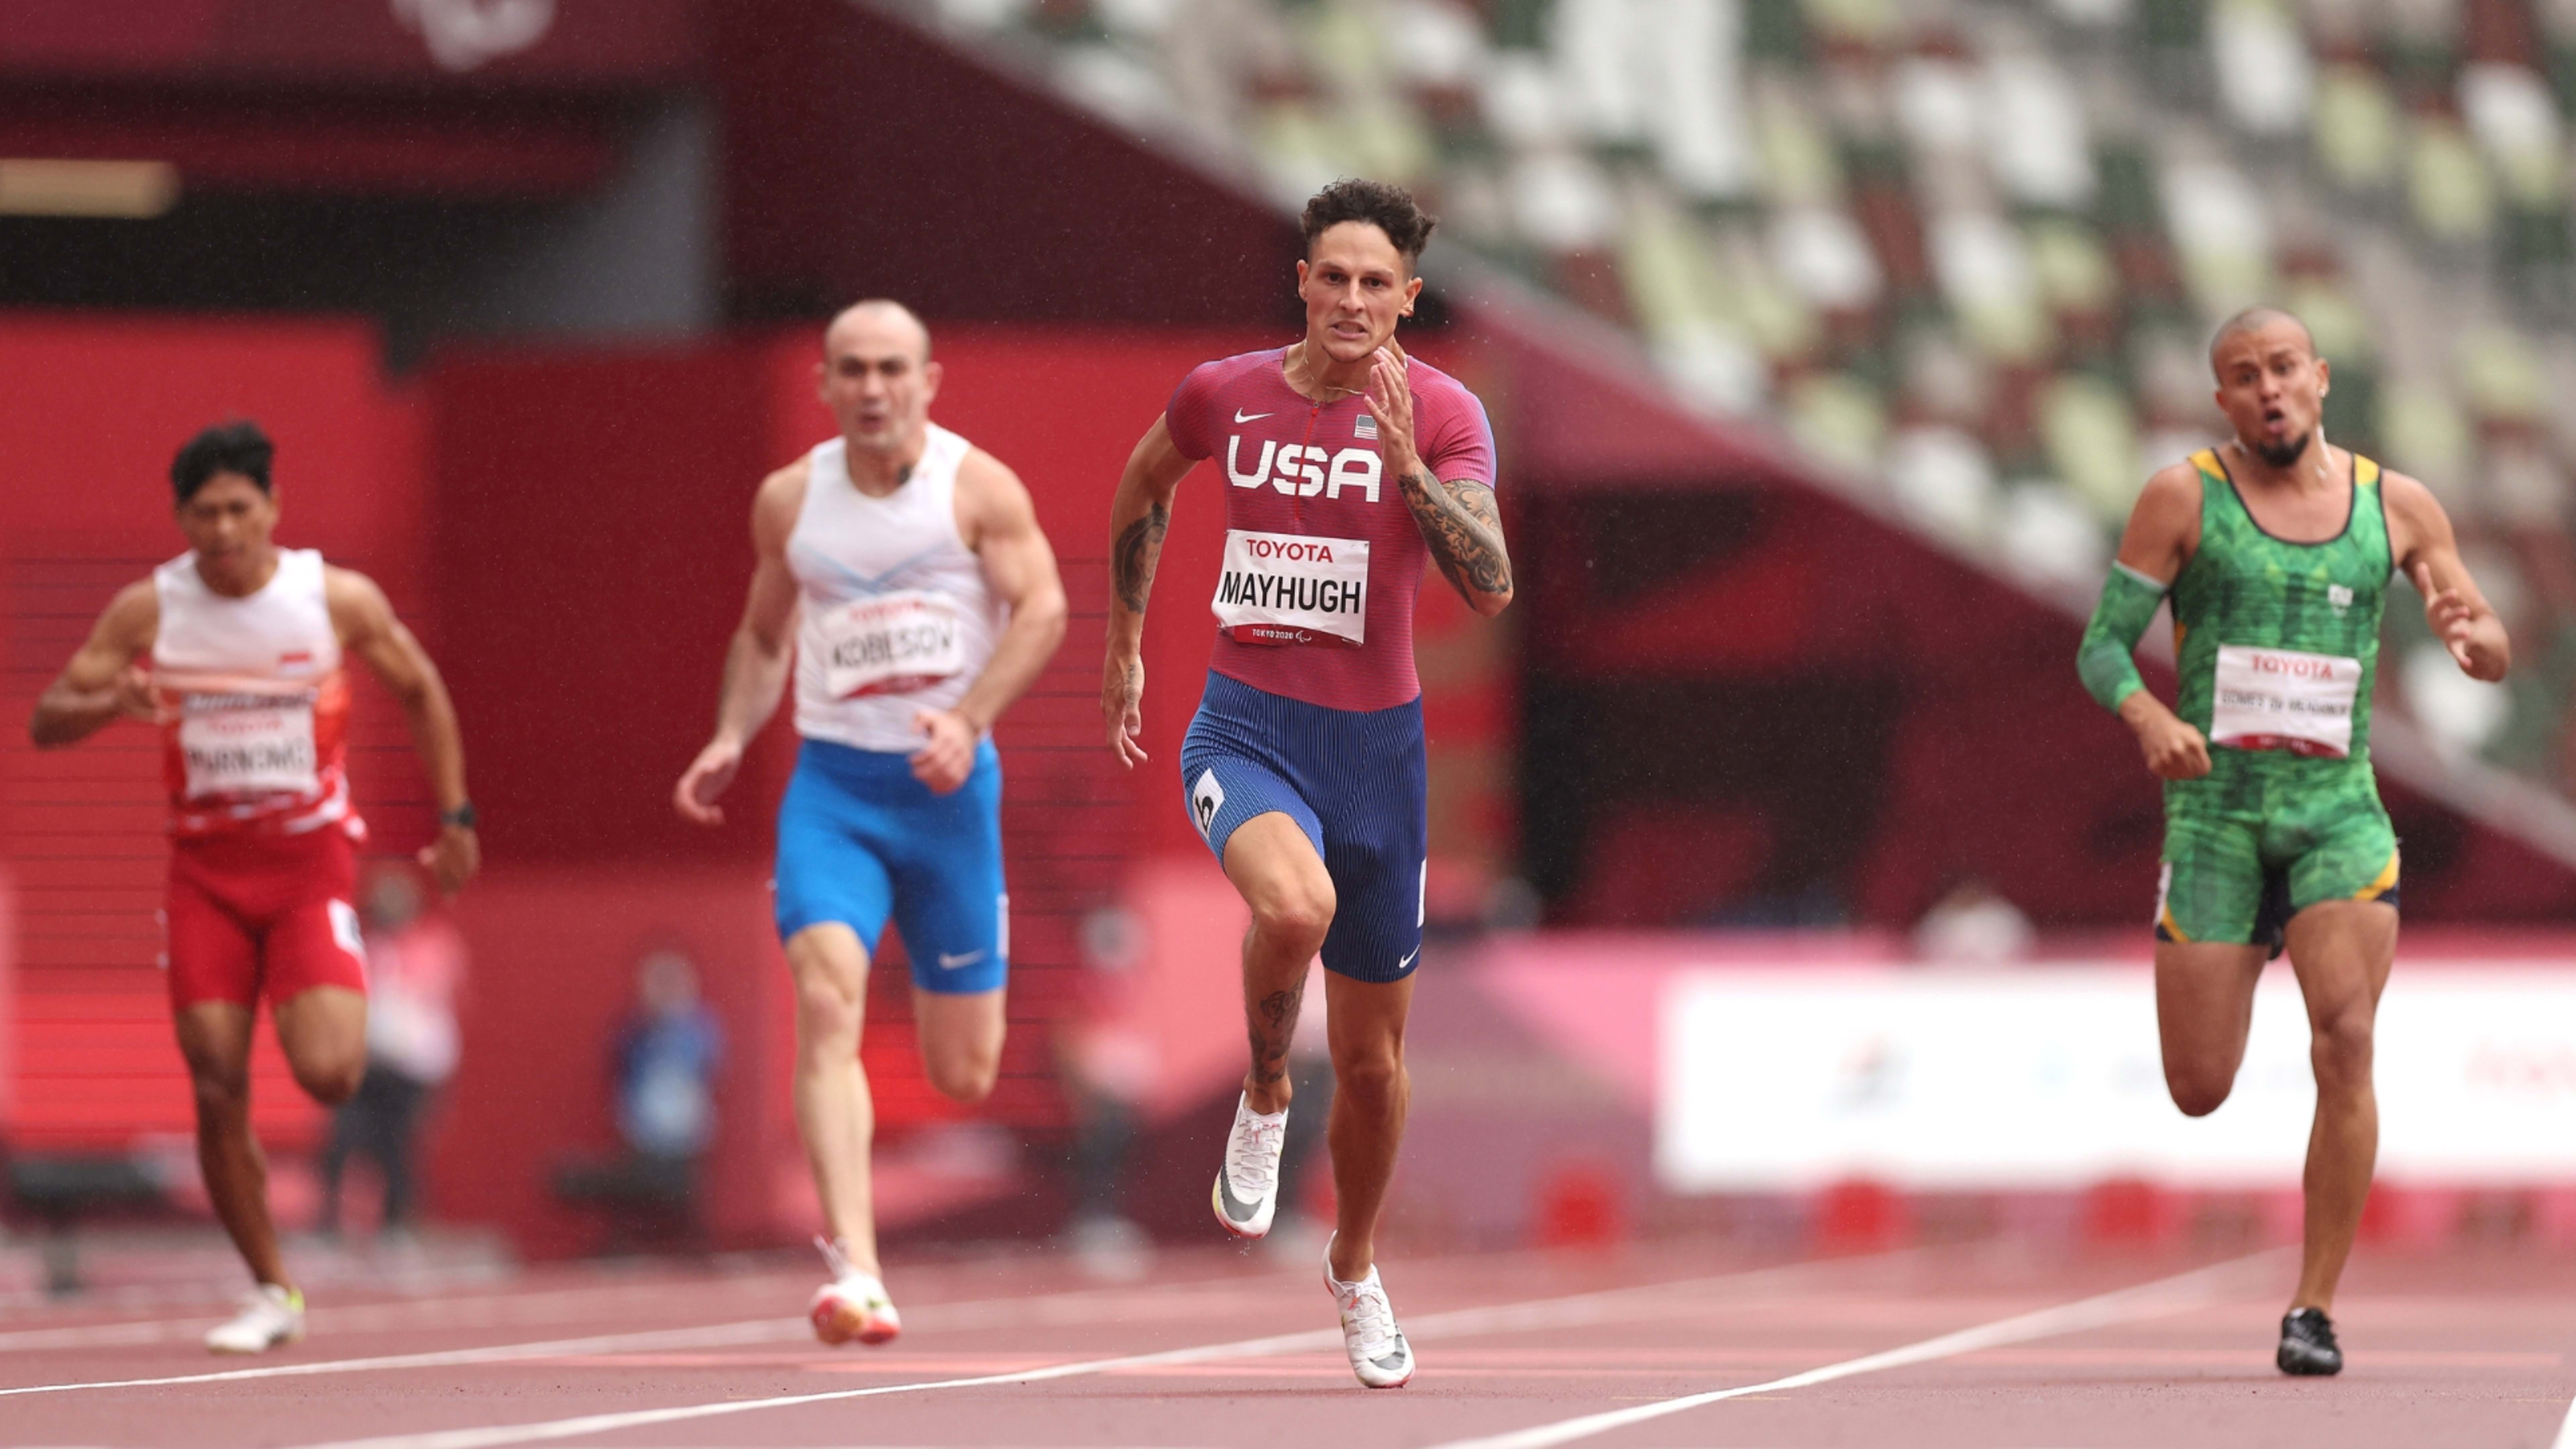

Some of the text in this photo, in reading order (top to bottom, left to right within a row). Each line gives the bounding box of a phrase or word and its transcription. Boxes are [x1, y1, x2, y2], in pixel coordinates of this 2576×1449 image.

[1227, 435, 1383, 502] USA
[1246, 539, 1333, 563] TOYOTA
[1219, 571, 1361, 614] MAYHUGH
[1252, 629, 1293, 639] TOKYO 2020
[2251, 653, 2334, 680] TOYOTA
